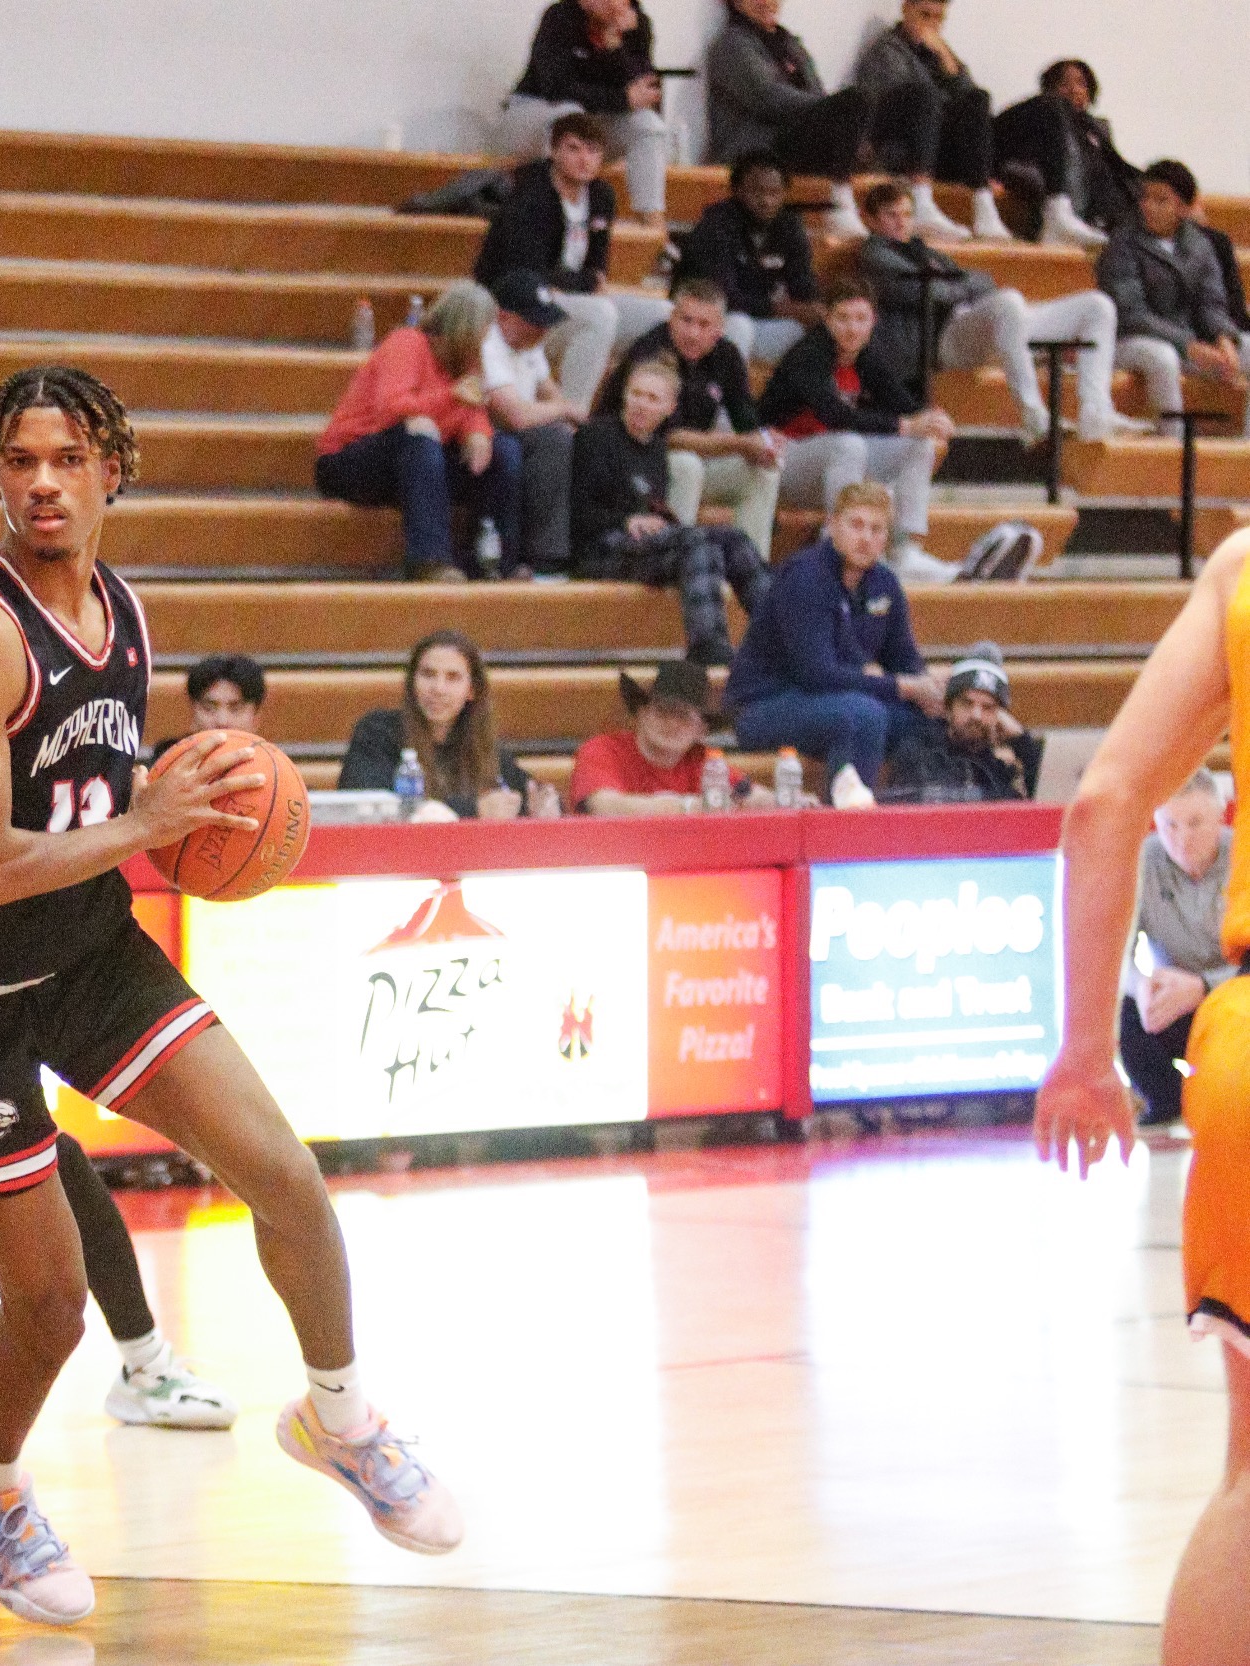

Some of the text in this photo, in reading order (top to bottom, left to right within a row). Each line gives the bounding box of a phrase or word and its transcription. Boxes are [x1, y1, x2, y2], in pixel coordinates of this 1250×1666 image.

[655, 912, 778, 951] America's
[359, 957, 504, 1057] Pizza
[665, 969, 769, 1007] Favorite
[383, 1024, 476, 1104] Hut
